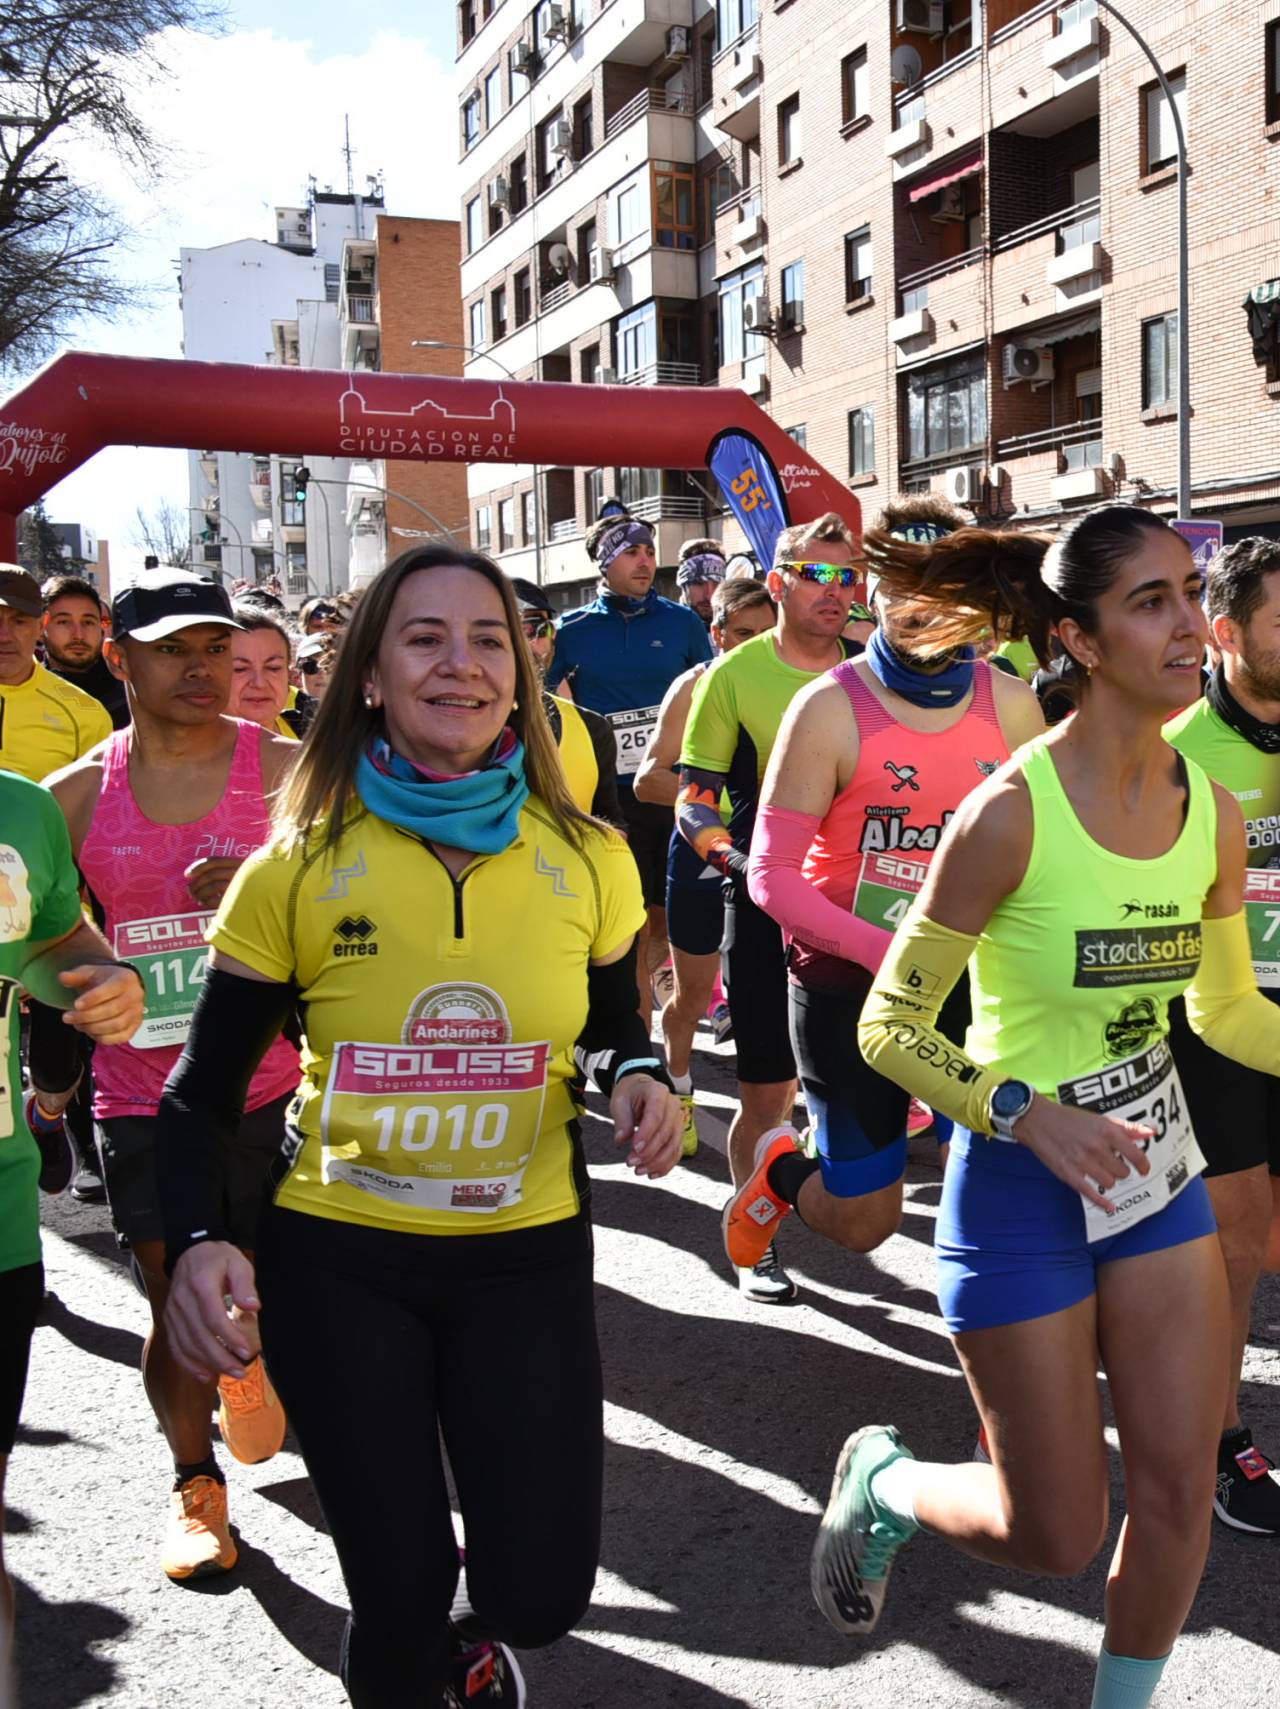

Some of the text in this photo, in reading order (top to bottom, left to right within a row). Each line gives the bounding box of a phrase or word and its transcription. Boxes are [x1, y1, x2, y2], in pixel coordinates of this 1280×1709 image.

[339, 438, 515, 459] CIUDAD REAL
[491, 432, 517, 444] DE
[612, 709, 660, 725] SOLIS
[621, 728, 656, 751] 26
[415, 1024, 499, 1040] Andarines
[354, 1049, 536, 1077] SOLISS
[375, 1076, 511, 1091] Seguros desde 1933
[1099, 1088, 1139, 1111] Seguros
[372, 1102, 510, 1152] 1010
